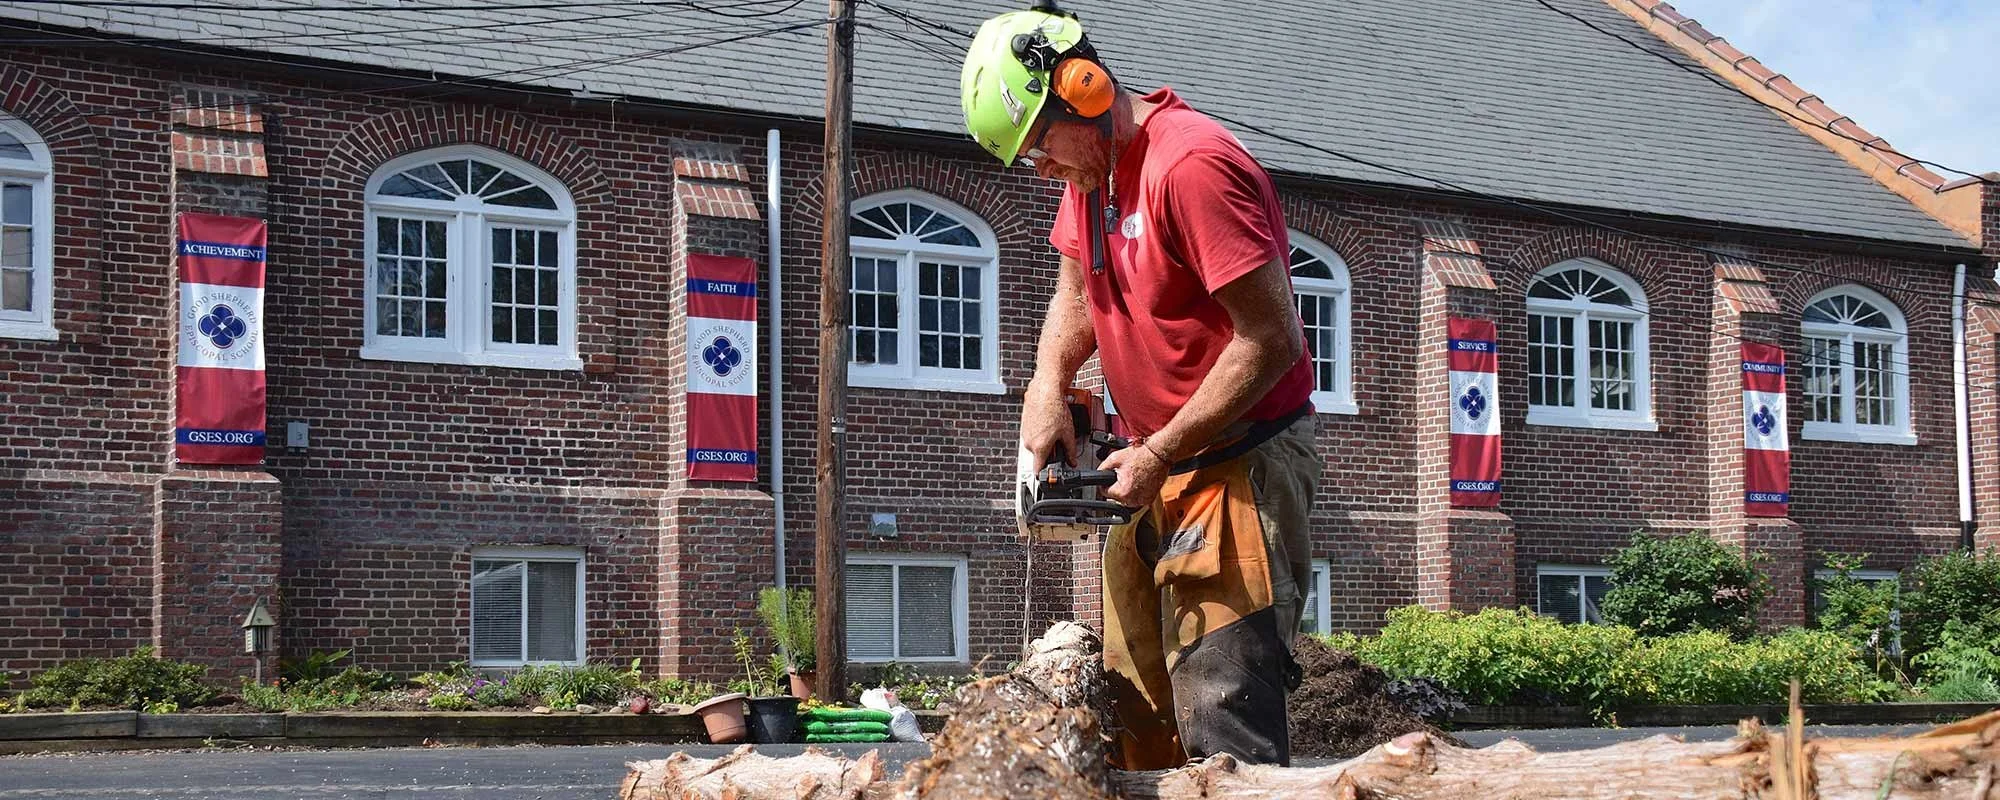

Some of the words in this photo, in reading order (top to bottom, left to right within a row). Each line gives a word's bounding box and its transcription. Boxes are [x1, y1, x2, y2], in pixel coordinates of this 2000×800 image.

[1081, 71, 1094, 87] 3M
[183, 244, 263, 259] ACHIEVEMENT
[707, 282, 738, 294] FAITH
[187, 295, 209, 320] GOOD
[211, 292, 257, 324] SHEPHERD
[184, 324, 229, 361] EPISCOPAL
[230, 330, 258, 360] SCHOOL
[694, 328, 711, 350] GOOD
[713, 325, 750, 353] SHEPHERD
[1457, 341, 1488, 351] SERVICE
[728, 359, 752, 386] SCHOOL
[188, 431, 254, 443] GSES.ORG
[696, 450, 747, 462] GSES.ORG
[1457, 481, 1495, 491] GSES.ORG
